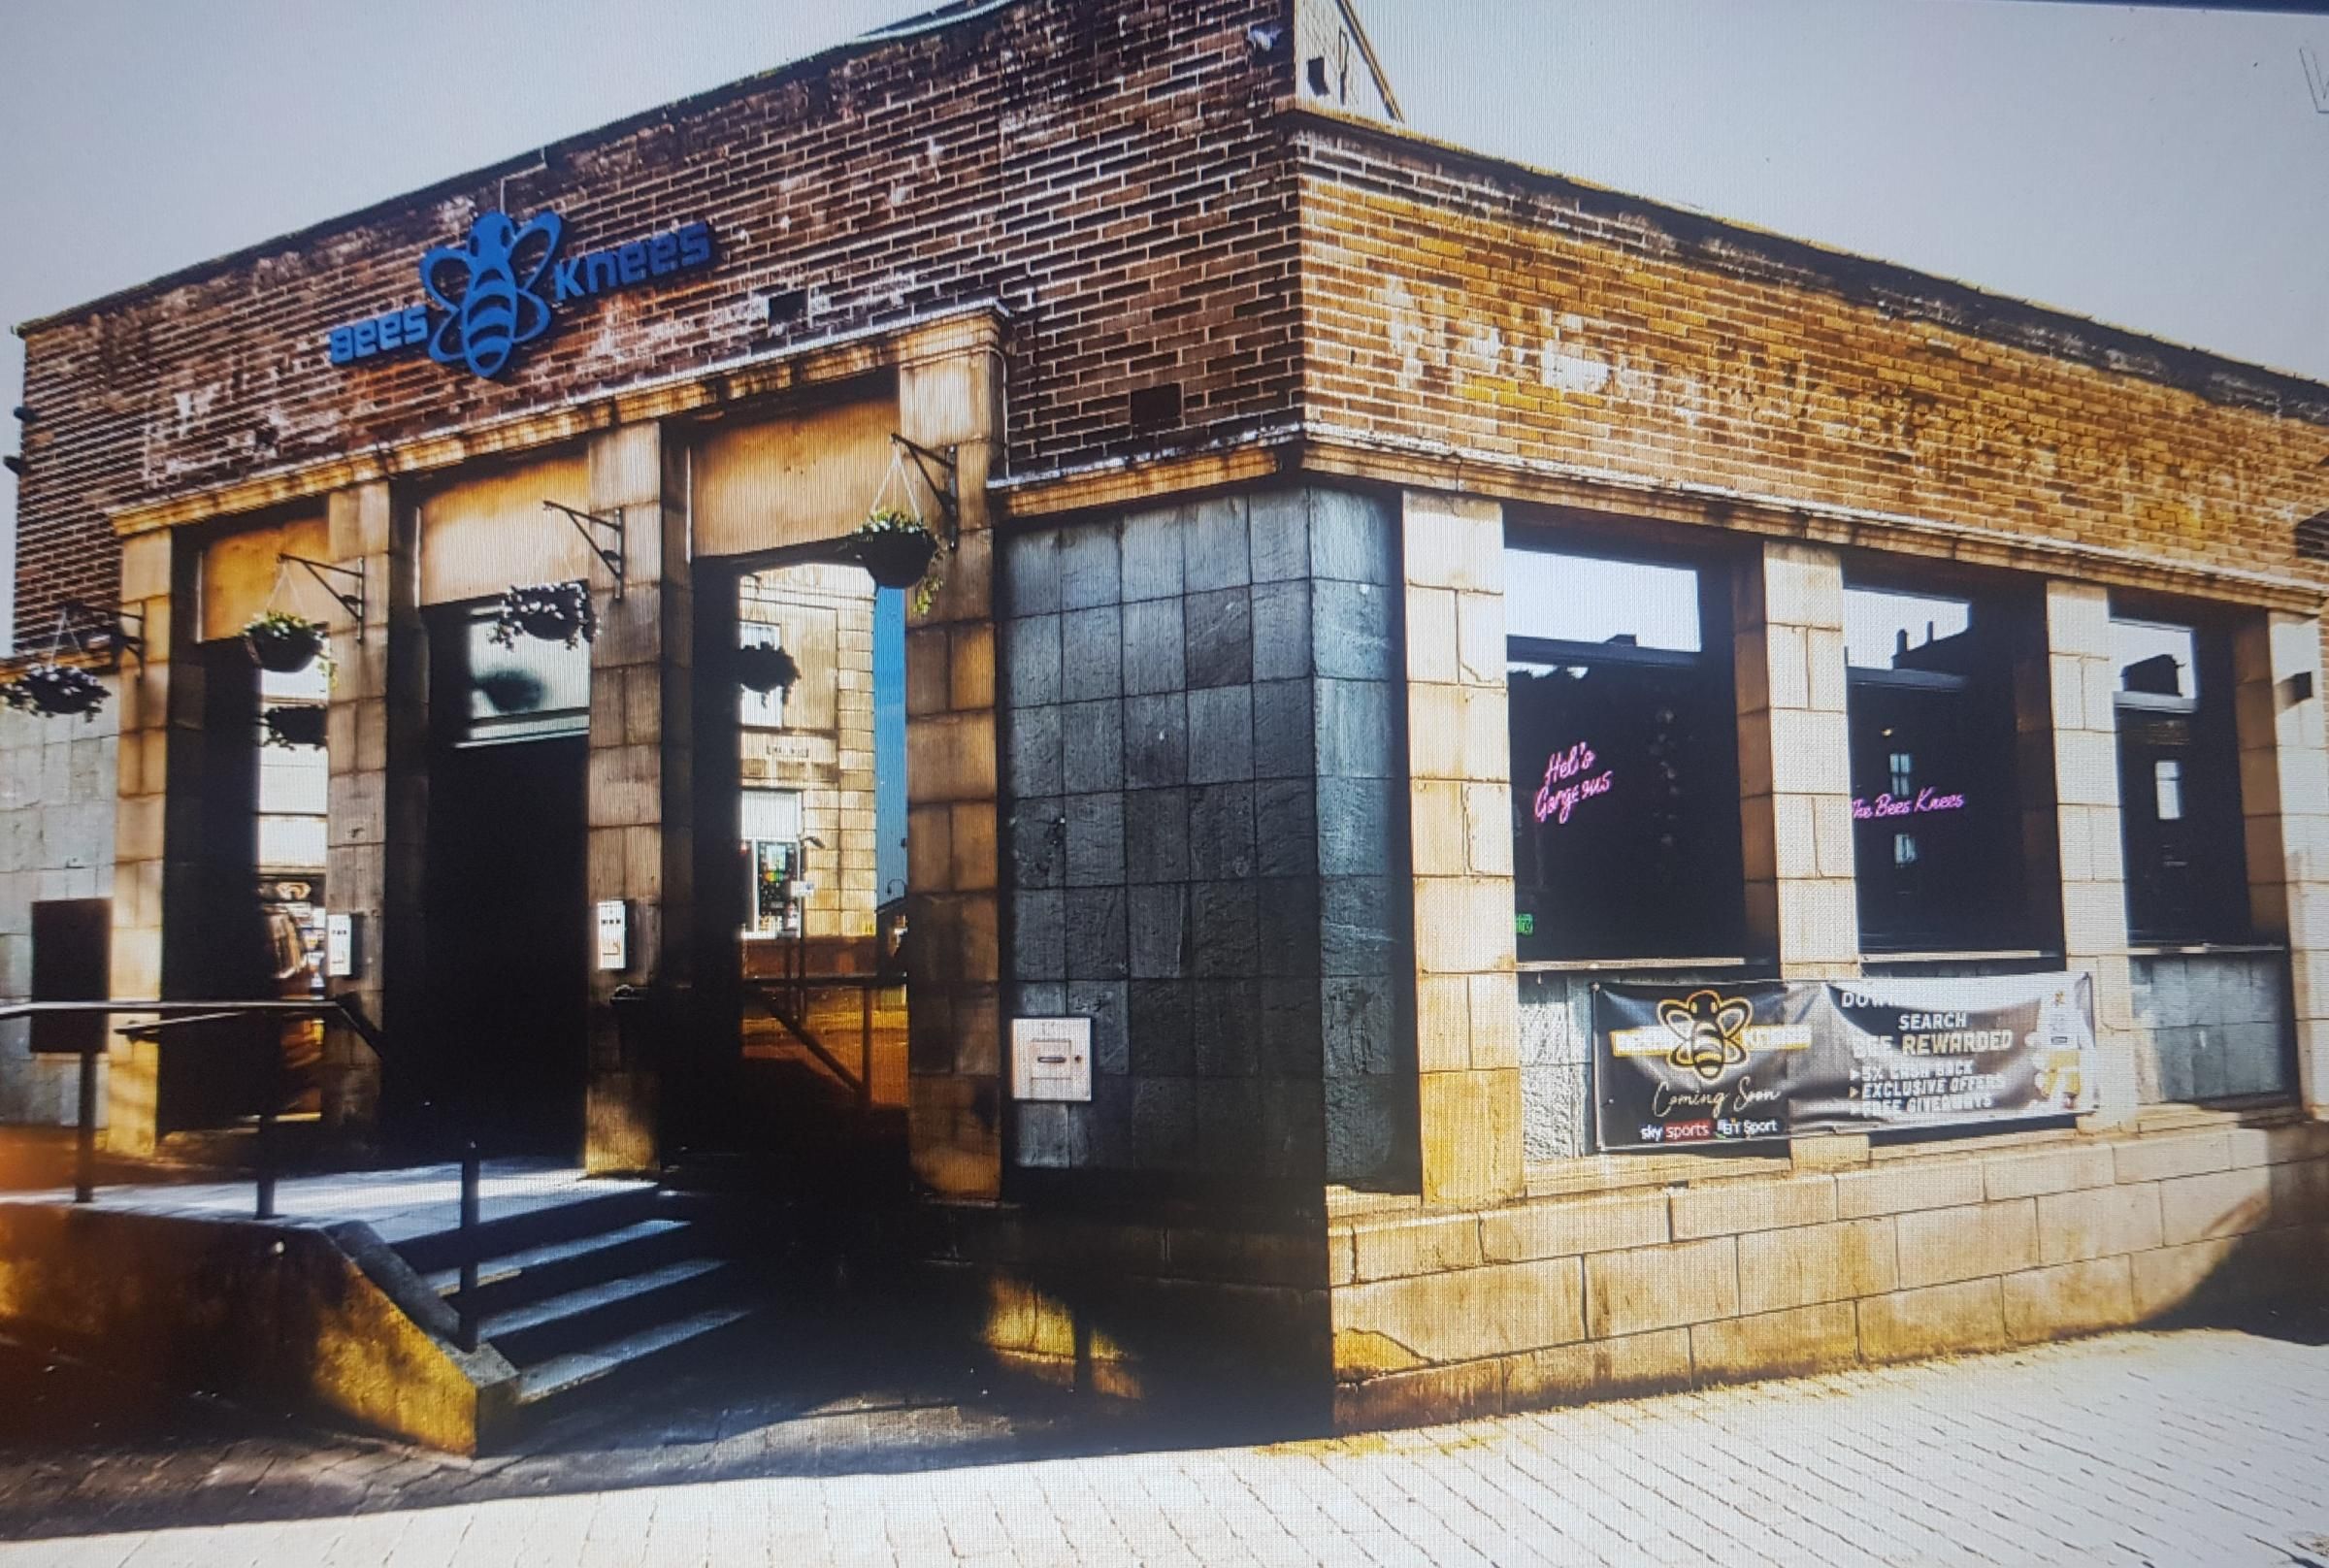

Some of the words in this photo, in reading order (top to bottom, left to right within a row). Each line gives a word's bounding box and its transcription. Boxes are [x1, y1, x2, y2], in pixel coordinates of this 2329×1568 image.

[1874, 793, 1912, 817] Bees
[1914, 786, 1965, 813] Knees
[1897, 1011, 1967, 1030] SEARCH
[1902, 1029, 2014, 1056] REWARDED
[1652, 1081, 1726, 1117] Coming
[1733, 1076, 1781, 1112] Soon
[1861, 1079, 1946, 1099] EXCLUSIVE
[1640, 1123, 1663, 1142] sky
[1665, 1123, 1710, 1140] sports
[1744, 1118, 1778, 1136] Sport
